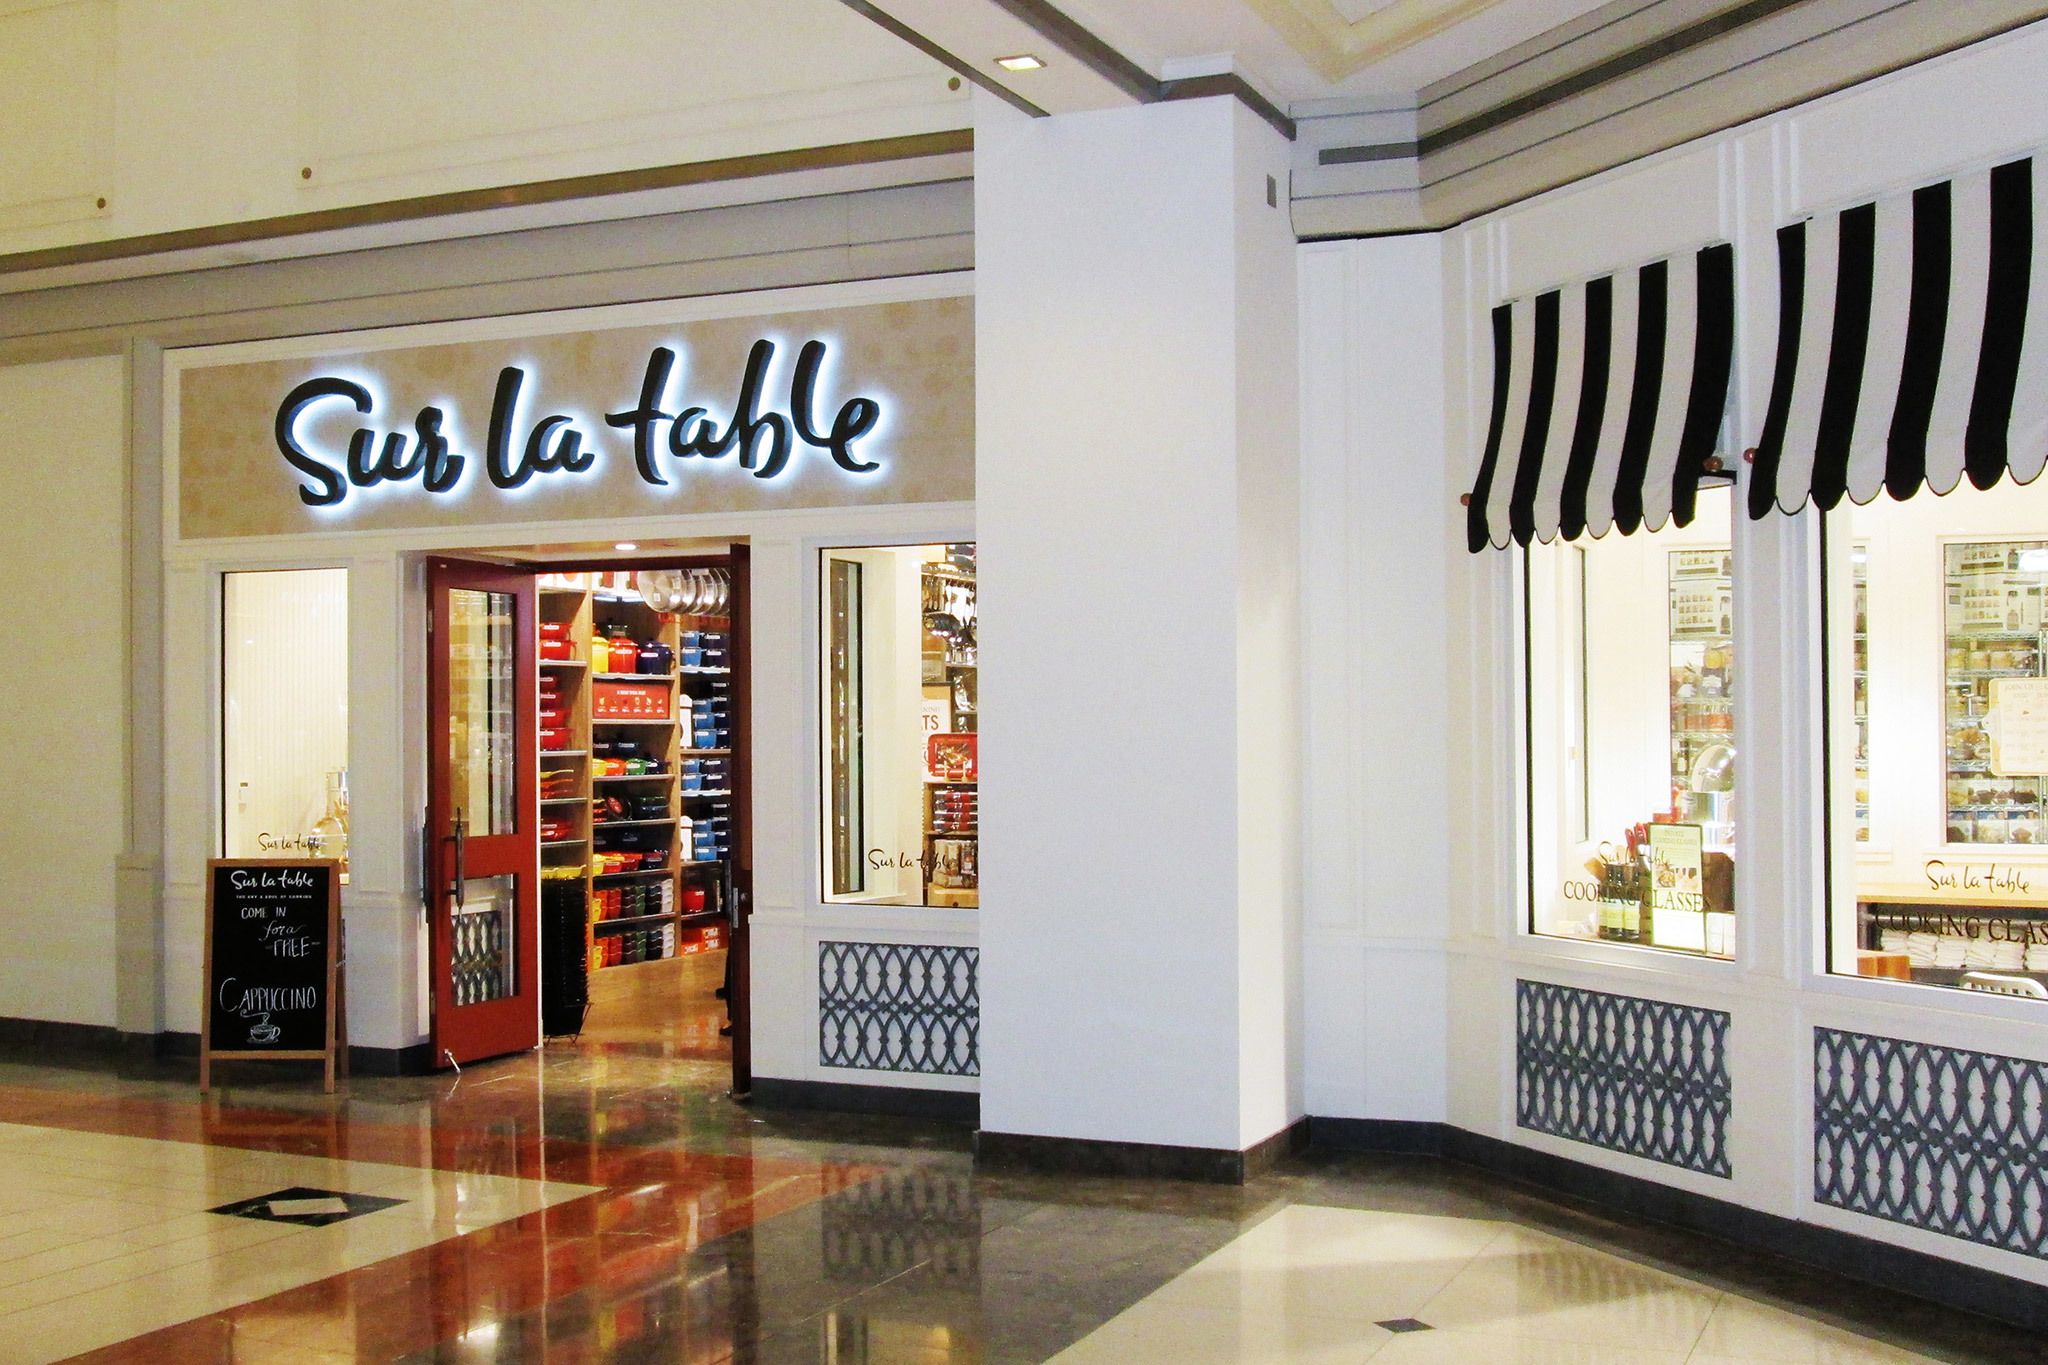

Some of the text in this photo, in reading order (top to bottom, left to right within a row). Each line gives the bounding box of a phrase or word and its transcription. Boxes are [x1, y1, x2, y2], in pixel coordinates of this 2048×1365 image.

[275, 338, 881, 506] Sur la table
[257, 832, 278, 851] Sur
[281, 835, 292, 850] la
[867, 848, 895, 870] Sur
[899, 852, 914, 869] la
[230, 869, 314, 890] Sur la table
[1925, 859, 2030, 894] Sur la table
[241, 906, 287, 919] COME IN
[1875, 909, 1980, 939] COOKING
[219, 977, 317, 1012] CAPPUCCINO
